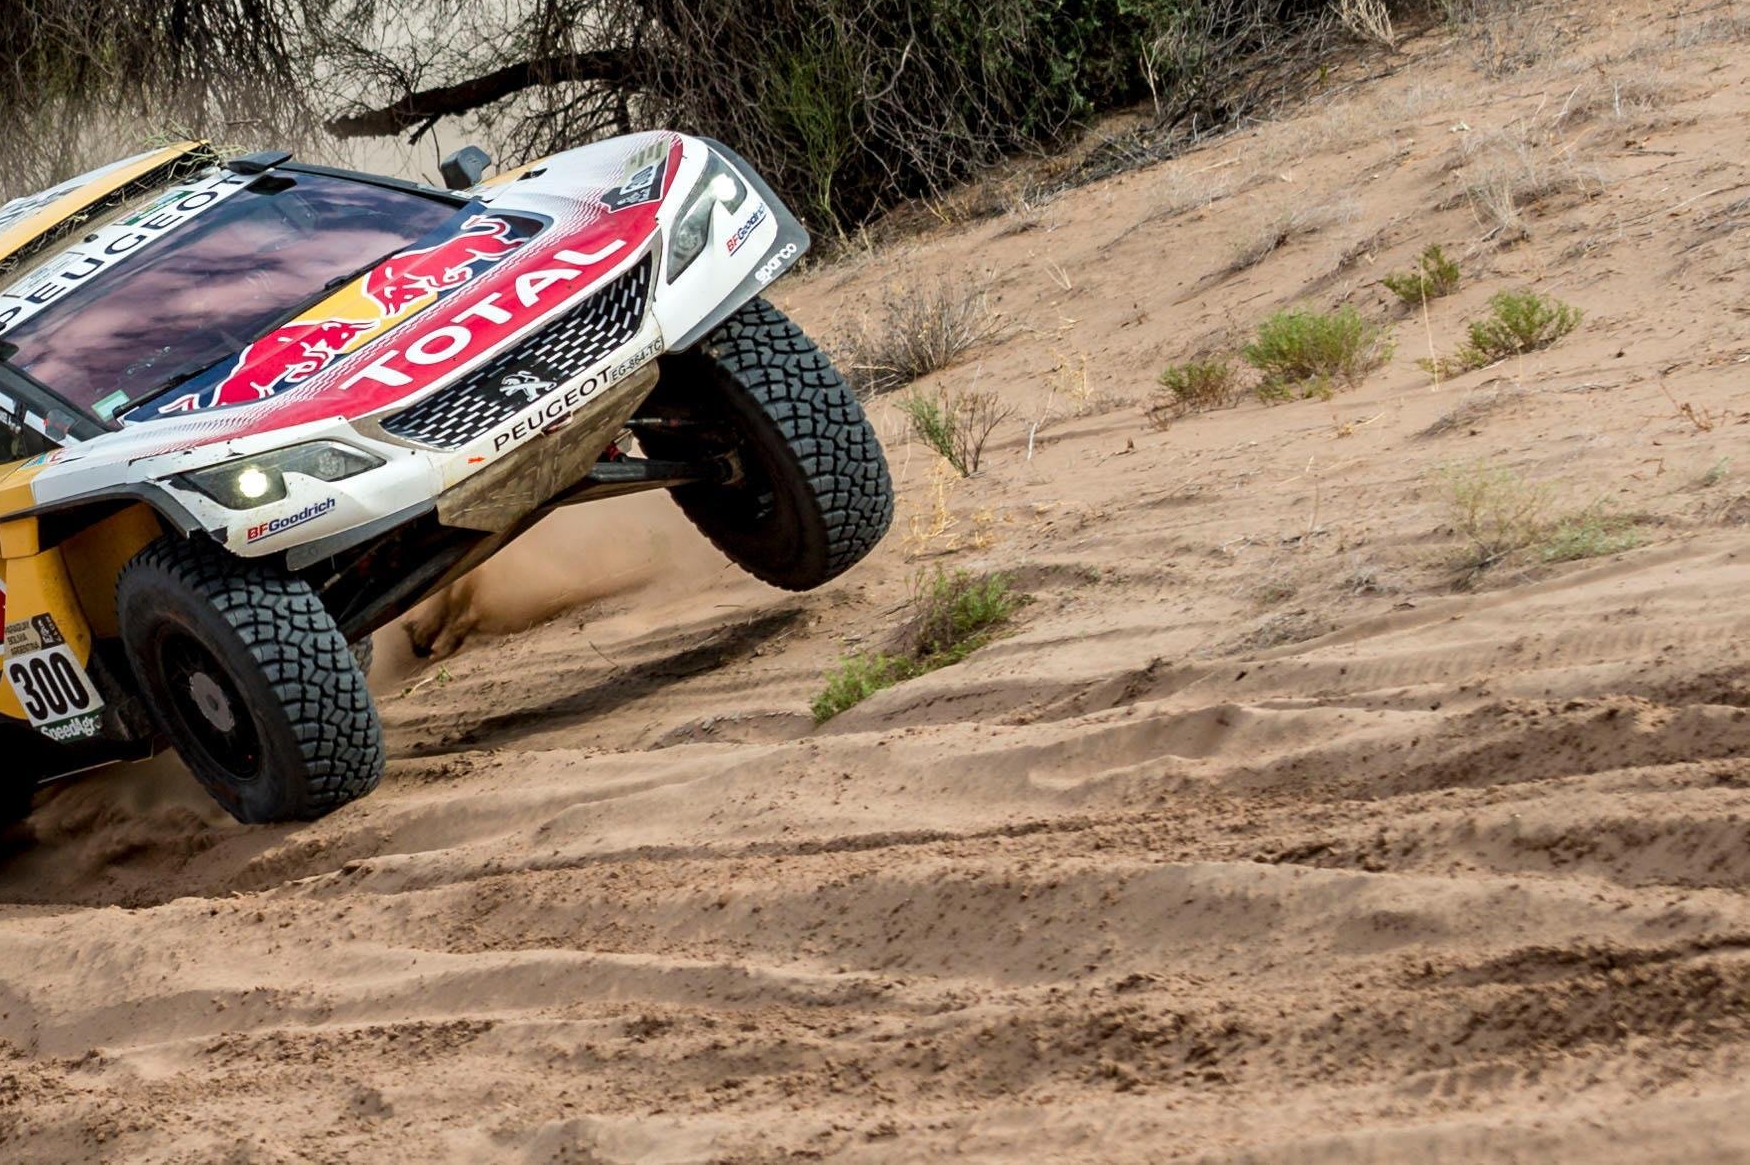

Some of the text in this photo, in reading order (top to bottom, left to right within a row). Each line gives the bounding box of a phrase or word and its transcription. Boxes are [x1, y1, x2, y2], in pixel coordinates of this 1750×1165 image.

[754, 243, 797, 285] sparco
[338, 239, 627, 391] TOTAL
[493, 365, 612, 452] PEUGEOT
[247, 498, 336, 540] BFGoodrich
[9, 652, 90, 721] 300
